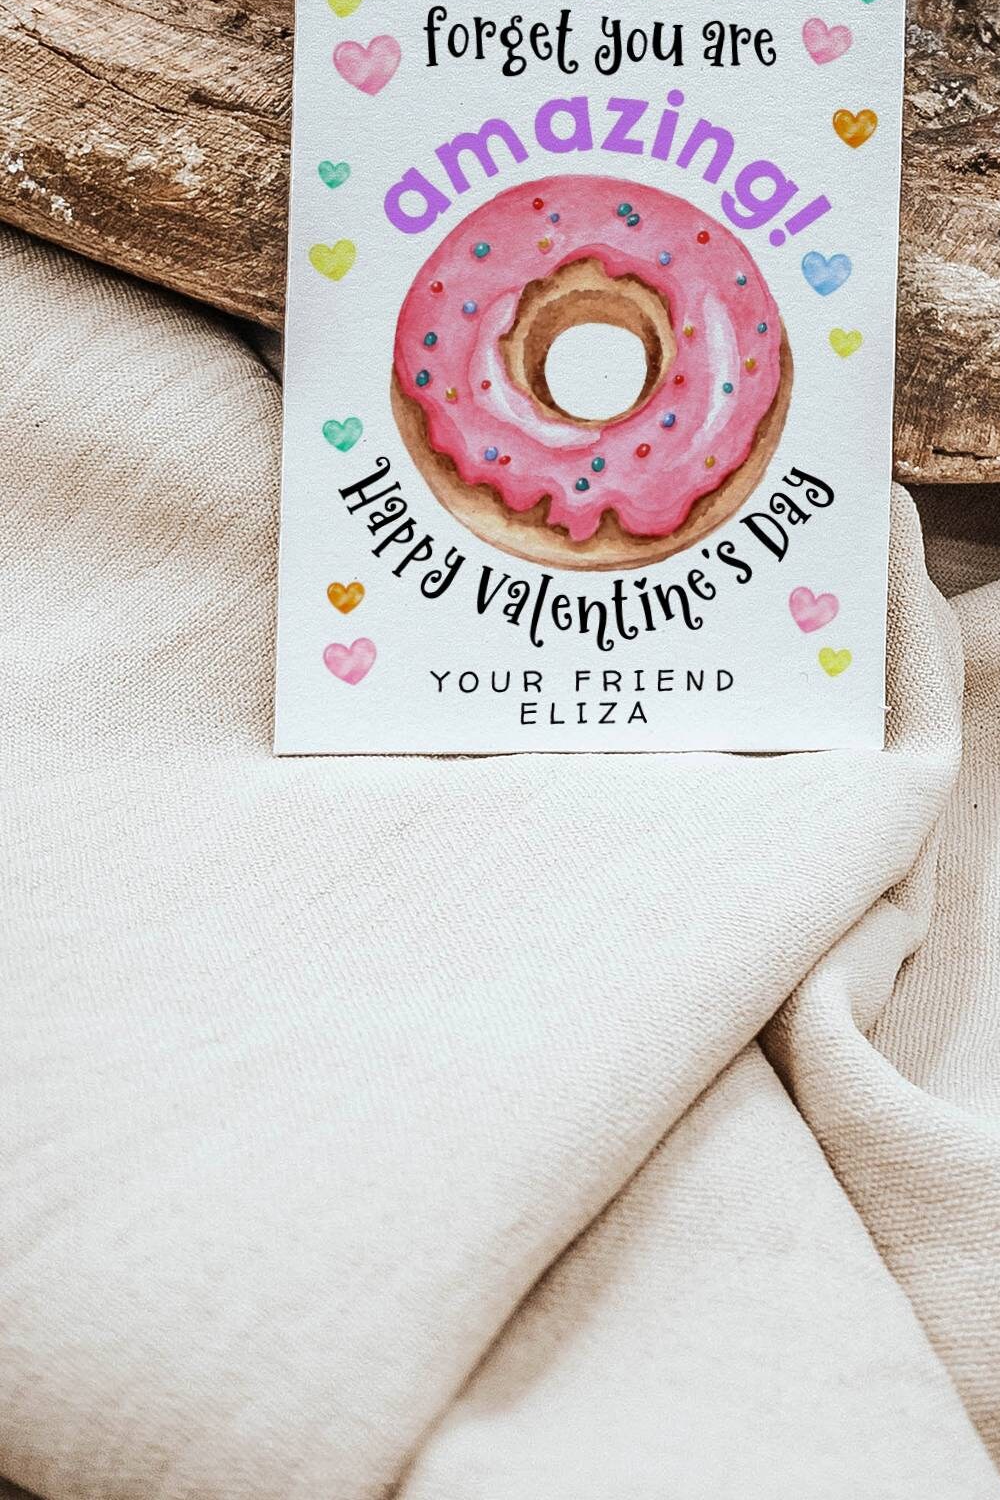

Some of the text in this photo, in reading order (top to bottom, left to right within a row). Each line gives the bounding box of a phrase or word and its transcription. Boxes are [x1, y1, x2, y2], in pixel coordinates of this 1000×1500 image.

[423, 5, 778, 77] forget you are
[383, 88, 833, 248] amazing!
[337, 456, 468, 600] Happy
[738, 465, 836, 563] Day
[428, 668, 737, 694] YOUR FRIEND
[518, 700, 651, 726] ELIZA
